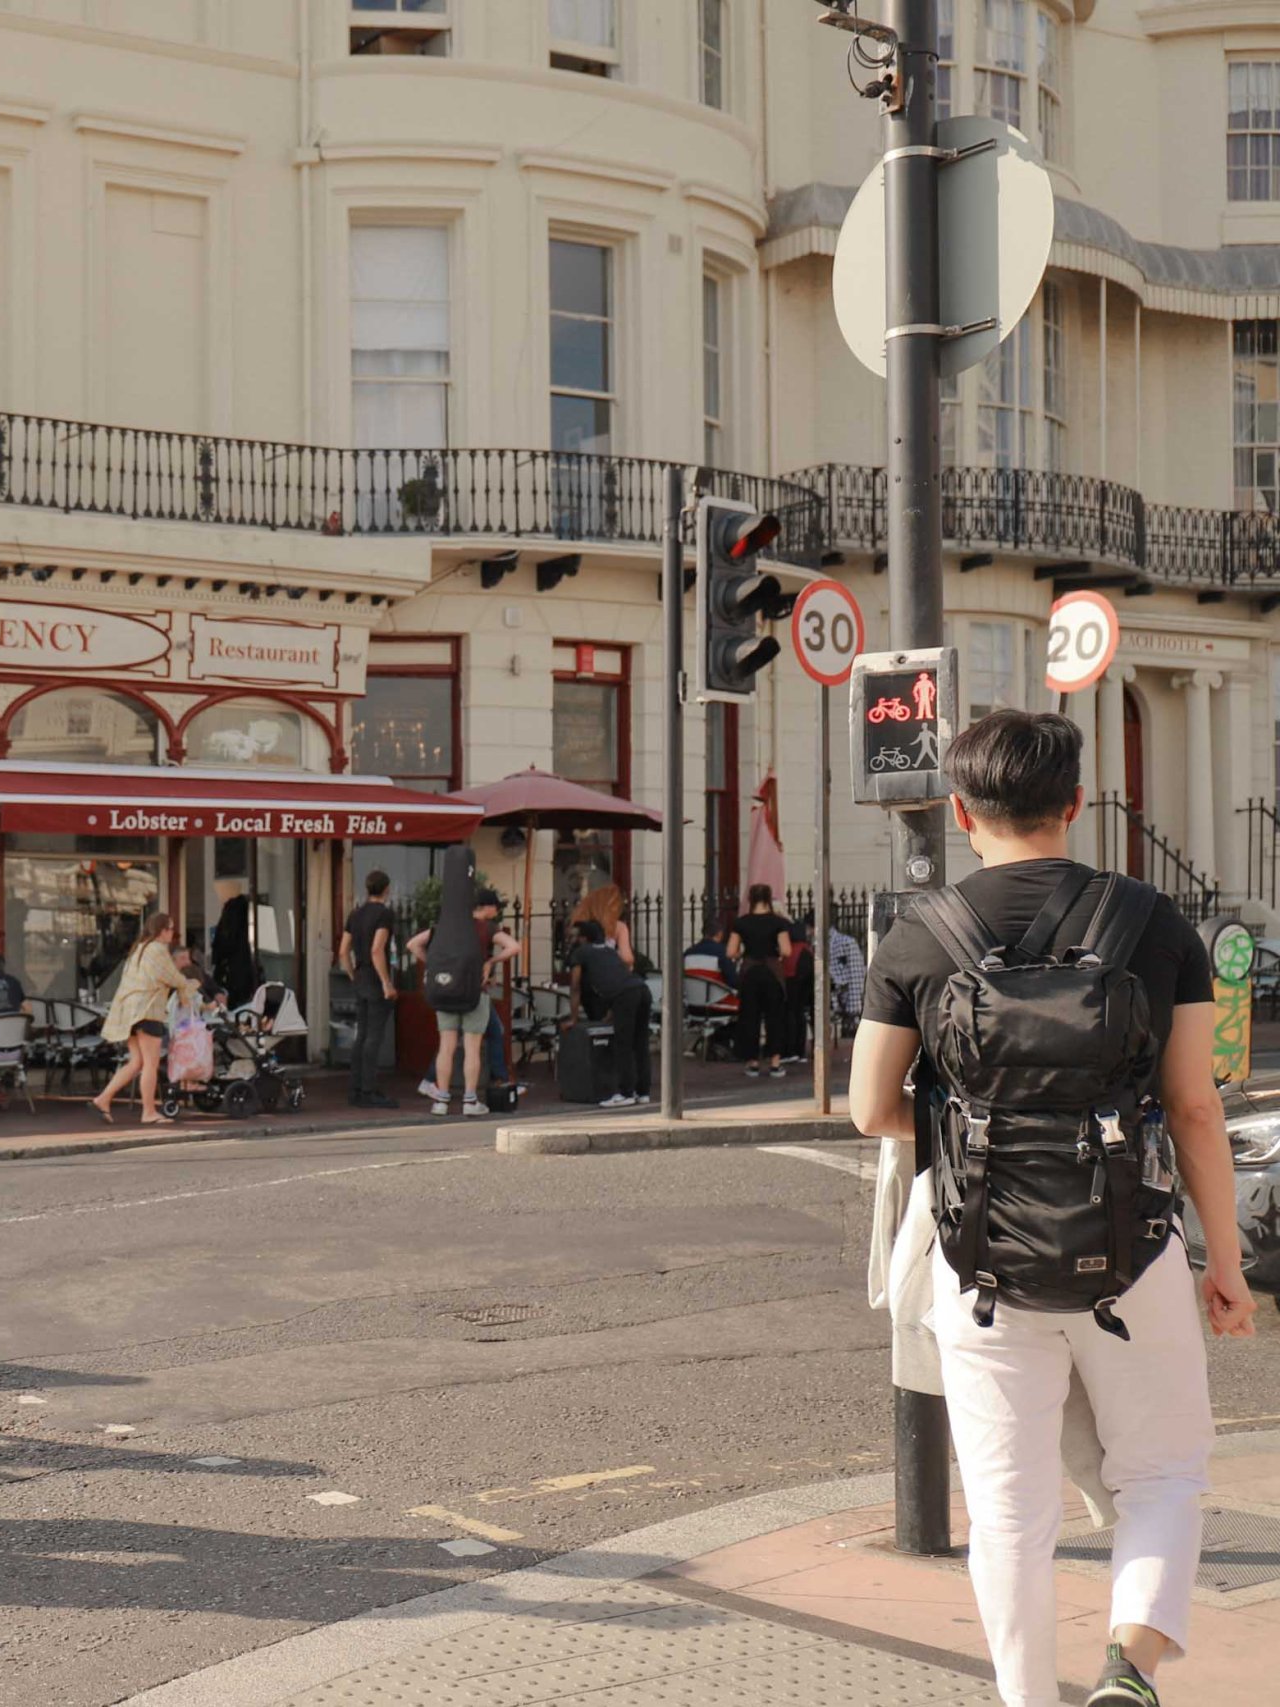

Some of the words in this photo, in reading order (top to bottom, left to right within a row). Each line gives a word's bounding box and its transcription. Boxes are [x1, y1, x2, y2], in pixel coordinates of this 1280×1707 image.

[804, 611, 854, 654] 30
[1048, 621, 1104, 663] 20
[1156, 633, 1203, 654] HOTEL
[209, 637, 320, 665] Restaurant
[109, 809, 188, 831] Lobster
[215, 812, 272, 832] Local
[280, 813, 335, 834] Fresh
[346, 815, 388, 835] Fish
